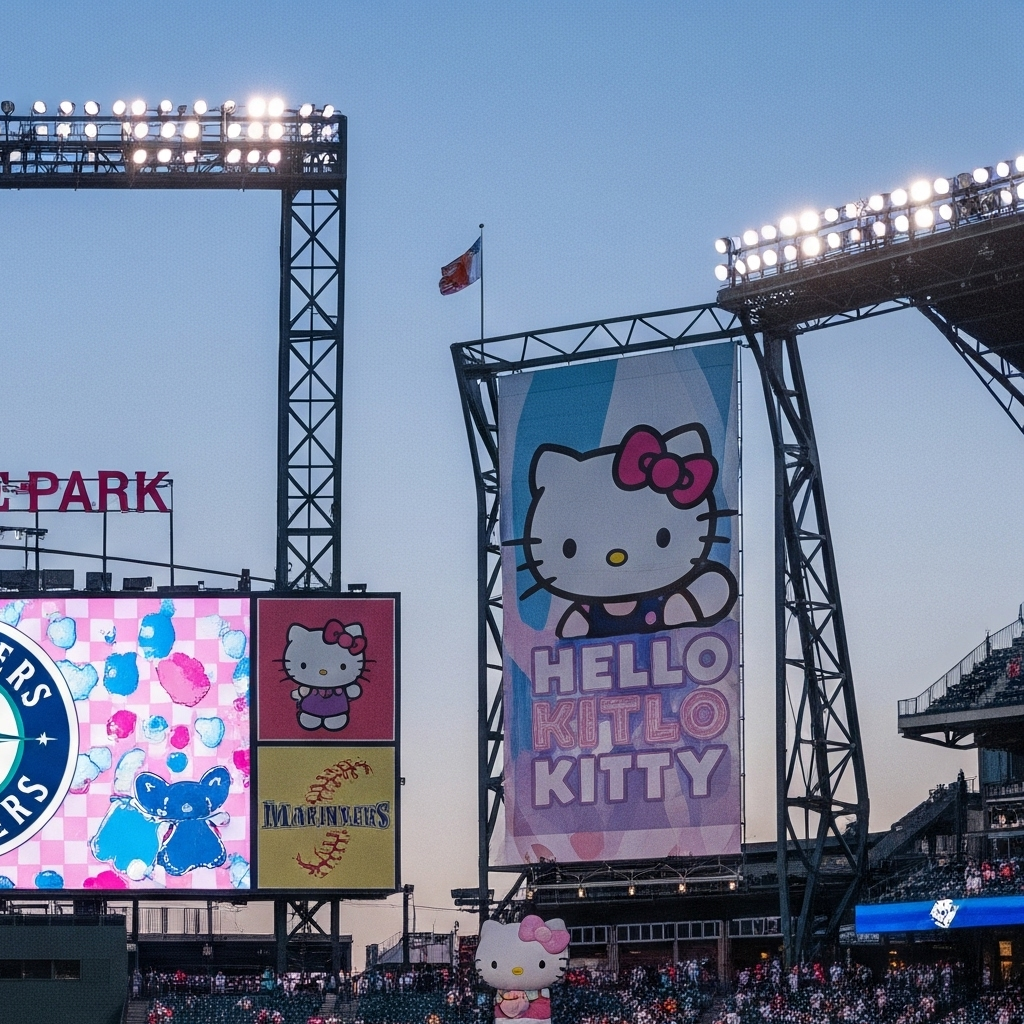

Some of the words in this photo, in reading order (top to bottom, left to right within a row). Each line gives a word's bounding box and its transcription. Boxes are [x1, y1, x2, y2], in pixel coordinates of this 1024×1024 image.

[28, 471, 170, 513] PARK
[531, 632, 732, 696] HELLO
[533, 688, 730, 751] KITLO
[531, 744, 728, 809] KITTY
